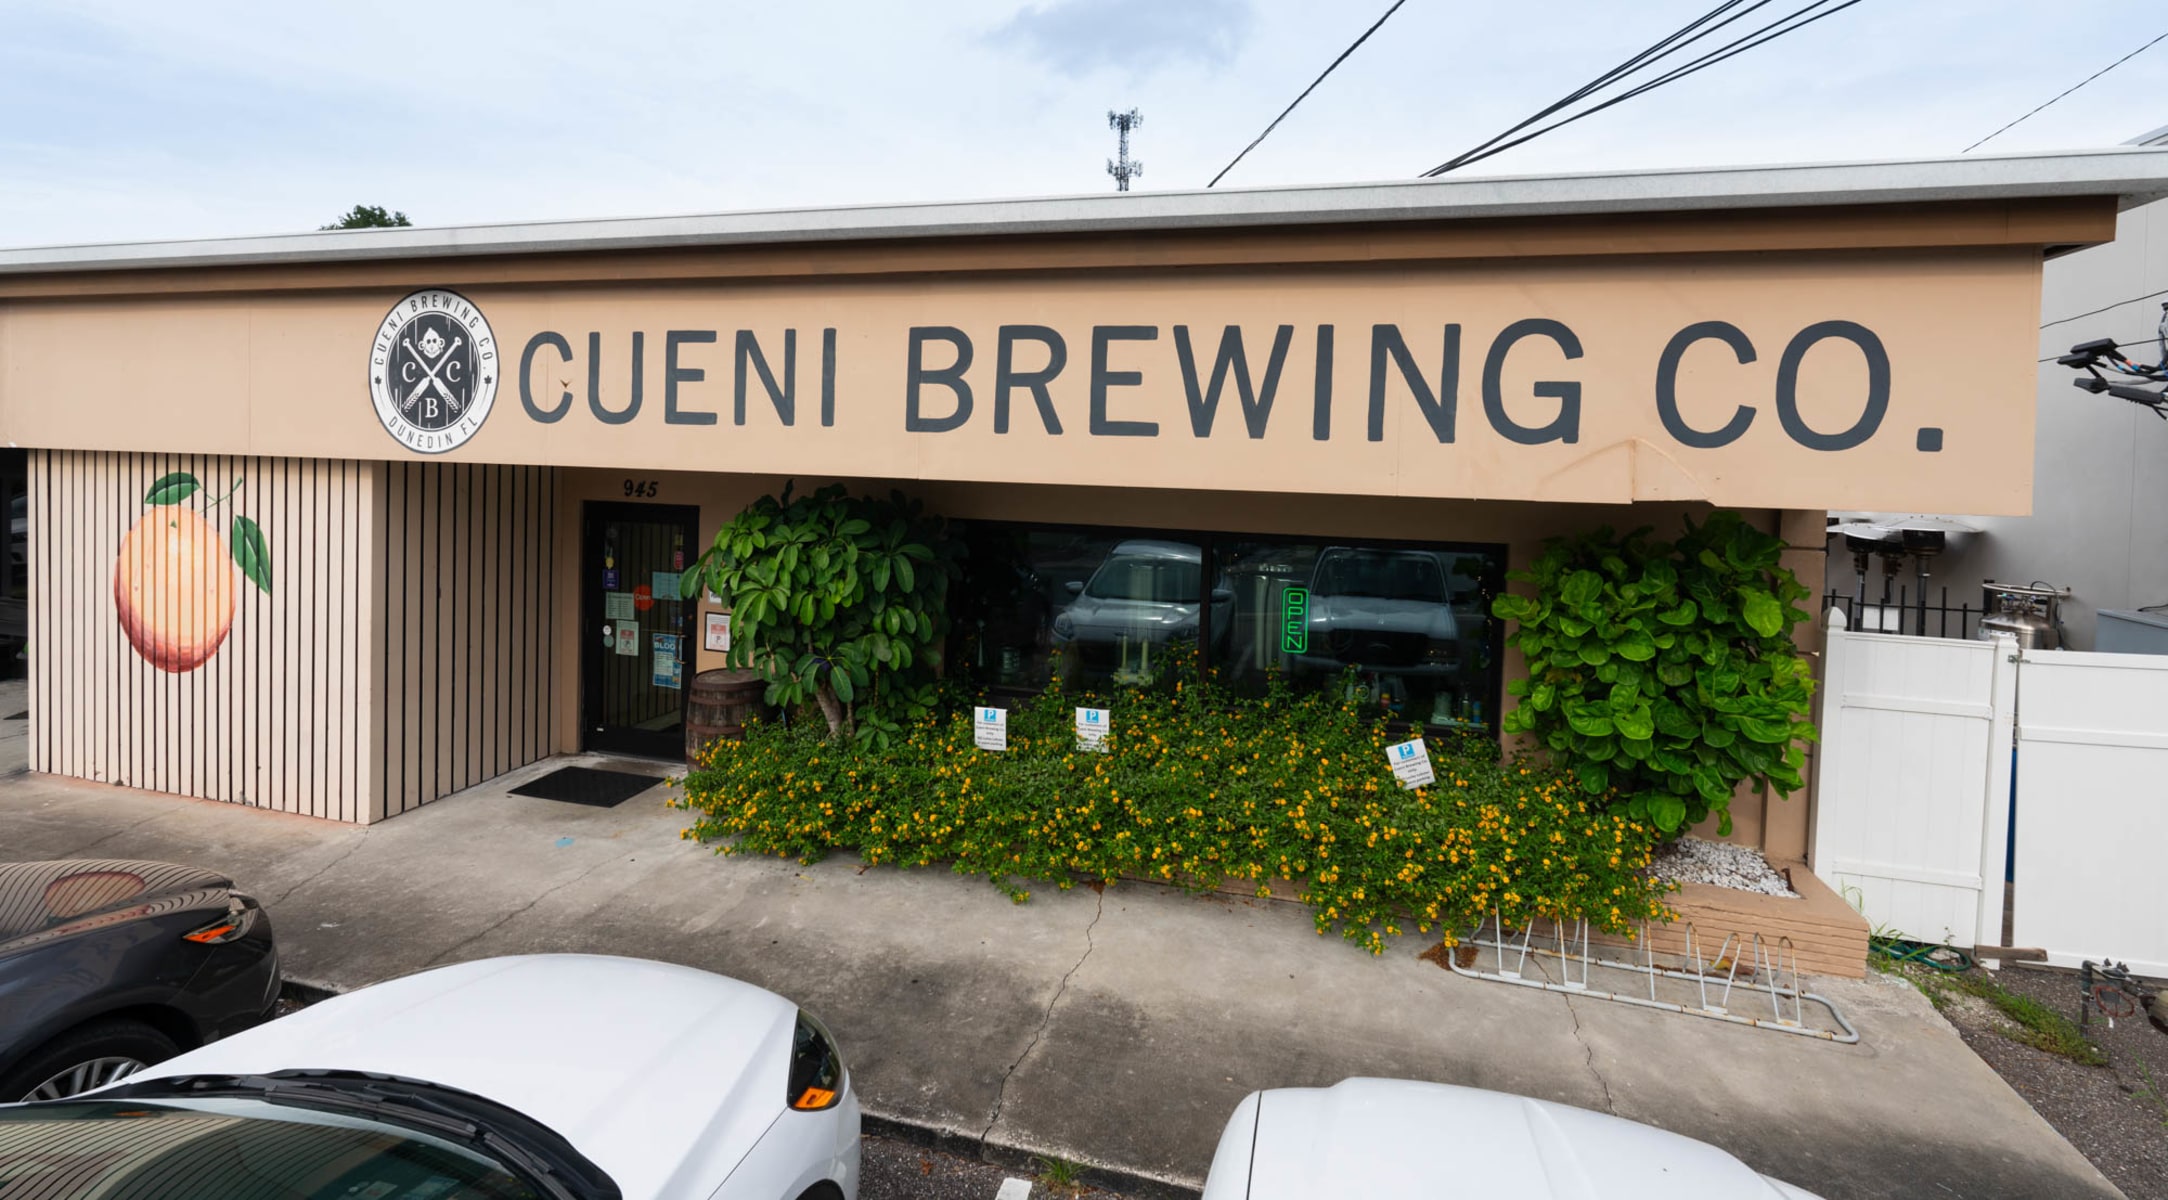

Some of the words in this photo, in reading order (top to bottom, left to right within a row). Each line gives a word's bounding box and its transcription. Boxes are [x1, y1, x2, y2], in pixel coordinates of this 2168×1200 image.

[374, 311, 404, 366] CUENI
[410, 294, 479, 329] BREWING
[402, 361, 416, 383] C
[446, 360, 461, 382] C
[519, 328, 836, 426] CUENI
[905, 318, 1584, 445] BREWING
[1656, 320, 1943, 452] CO.
[425, 397, 439, 418] B
[388, 416, 453, 449] DUNEDIN
[460, 416, 478, 445] FL
[623, 479, 659, 498] 945
[1287, 592, 1304, 649] OPEN
[654, 641, 679, 650] BLOO
